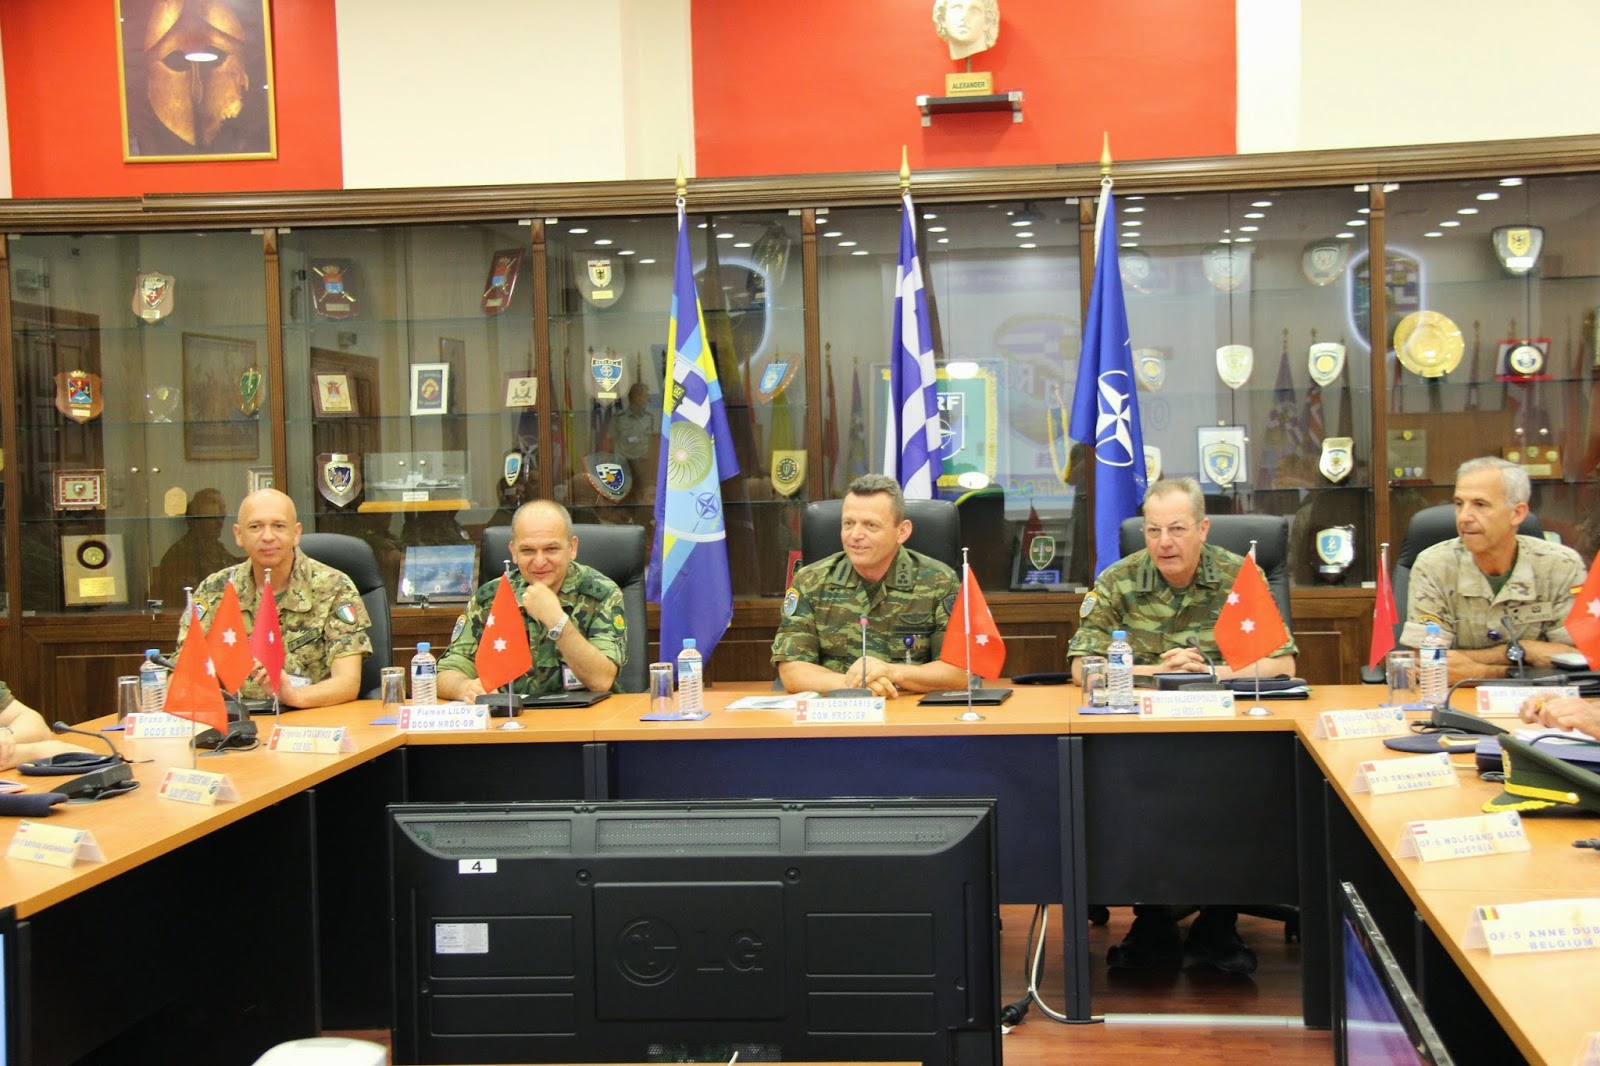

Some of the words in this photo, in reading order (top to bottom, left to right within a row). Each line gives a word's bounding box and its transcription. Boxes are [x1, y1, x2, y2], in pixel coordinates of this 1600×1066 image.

[952, 81, 986, 90] ALEXANDER
[828, 699, 871, 708] LEONTARIS
[417, 708, 446, 717] Plamen
[448, 707, 471, 715] LILOV
[812, 711, 828, 720] COM
[138, 715, 163, 724] Bruno
[412, 720, 435, 729] DCOM
[438, 719, 474, 728] NRDC-GR
[1397, 781, 1432, 790] ALBANIA
[1444, 832, 1494, 845] WOLFGANG
[1498, 829, 1522, 839] BACK
[1454, 844, 1494, 855] AUSTRIA
[472, 860, 482, 872] 4
[1528, 927, 1566, 938] ANNE
[1529, 938, 1593, 950] BELGIUM
[696, 929, 764, 972] LG
